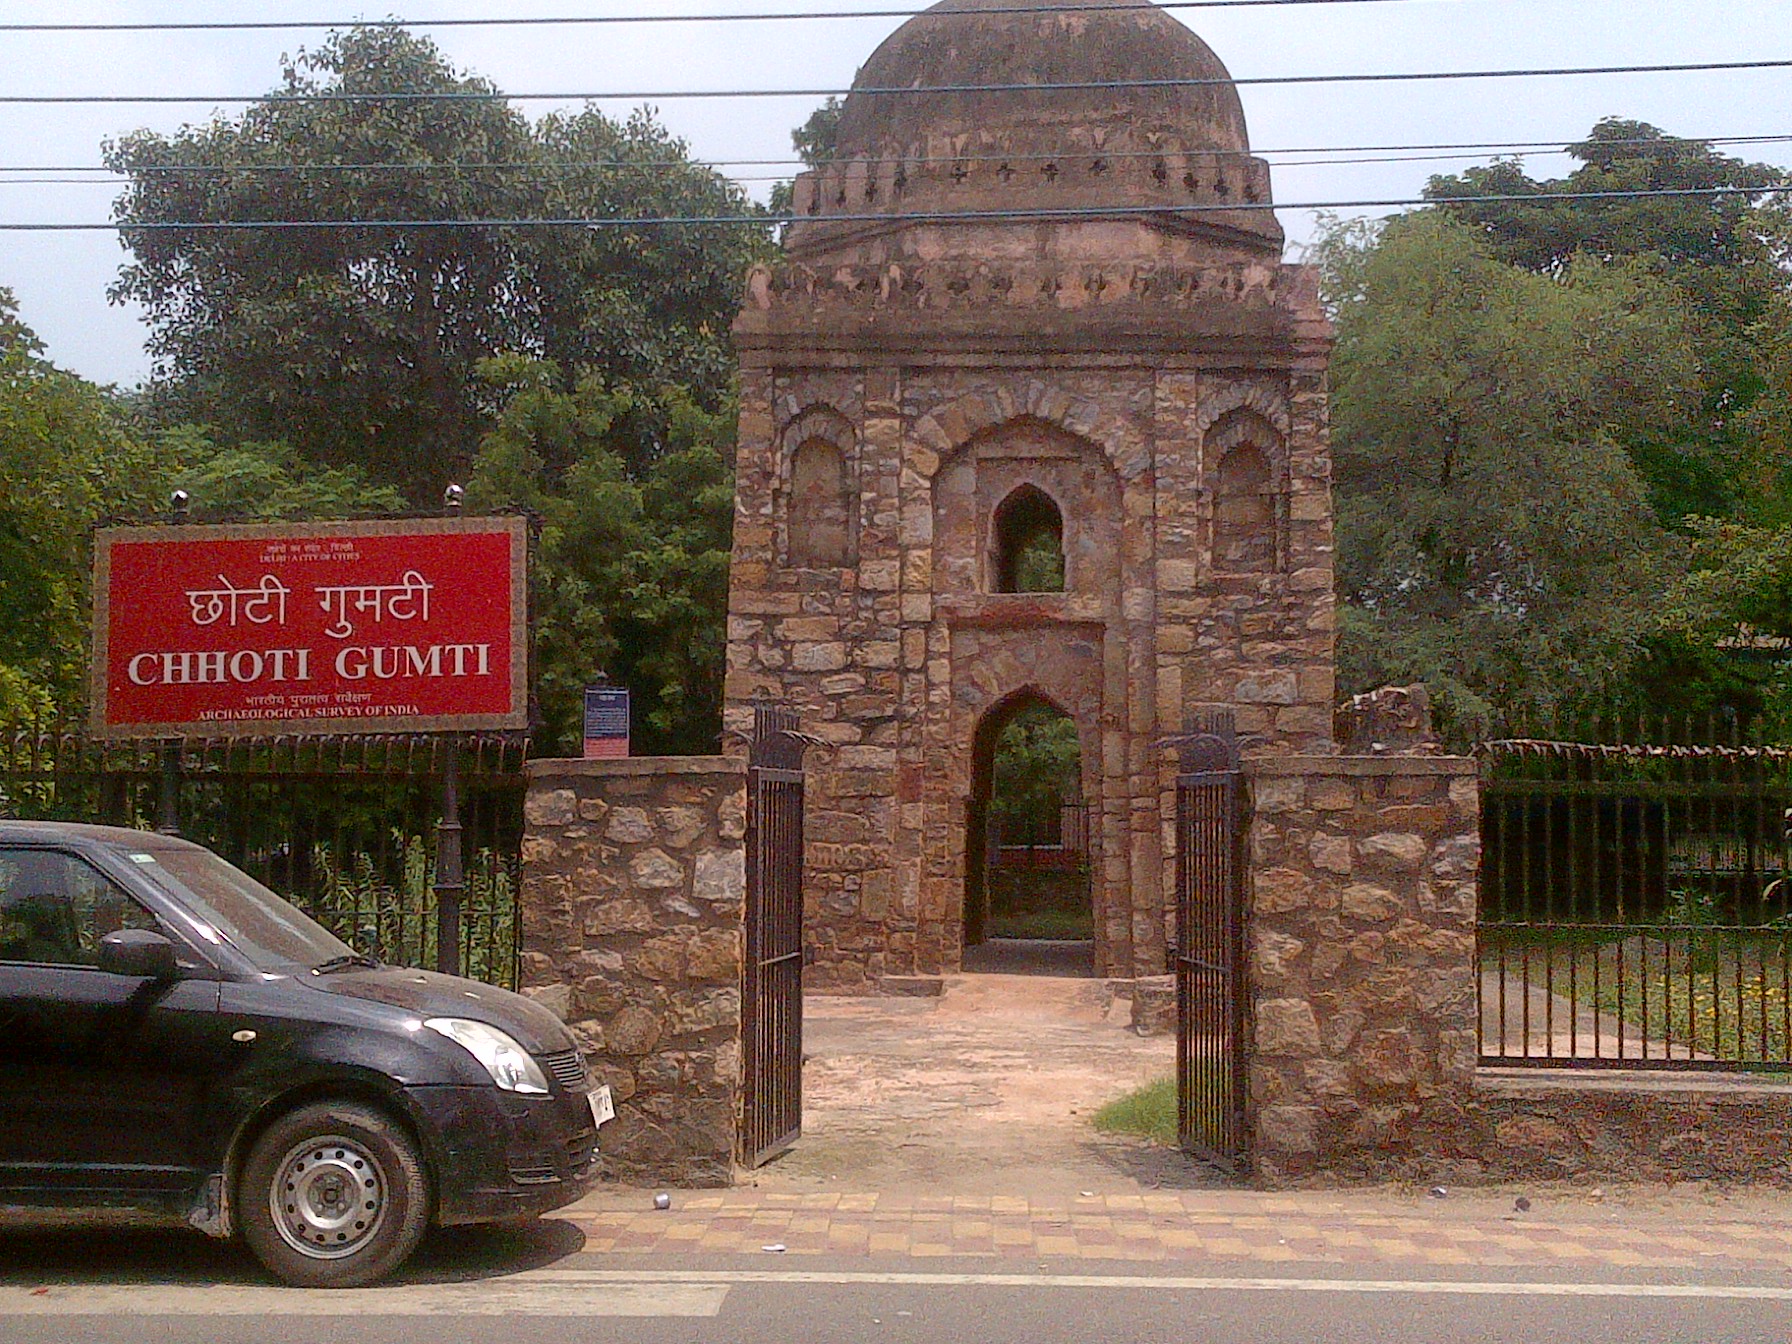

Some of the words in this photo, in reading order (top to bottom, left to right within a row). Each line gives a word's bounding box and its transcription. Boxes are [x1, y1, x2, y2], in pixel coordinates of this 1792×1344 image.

[185, 573, 291, 627] छोटी
[314, 570, 434, 639] गुमटी
[128, 649, 312, 686] CHHOTI
[335, 643, 491, 680] GUMTI
[197, 706, 314, 721] ARCHAEOLOGICAL
[314, 706, 363, 718] SURVEY
[365, 705, 383, 716] OF
[384, 704, 420, 716] INDIA
[246, 693, 285, 706] भारतीय
